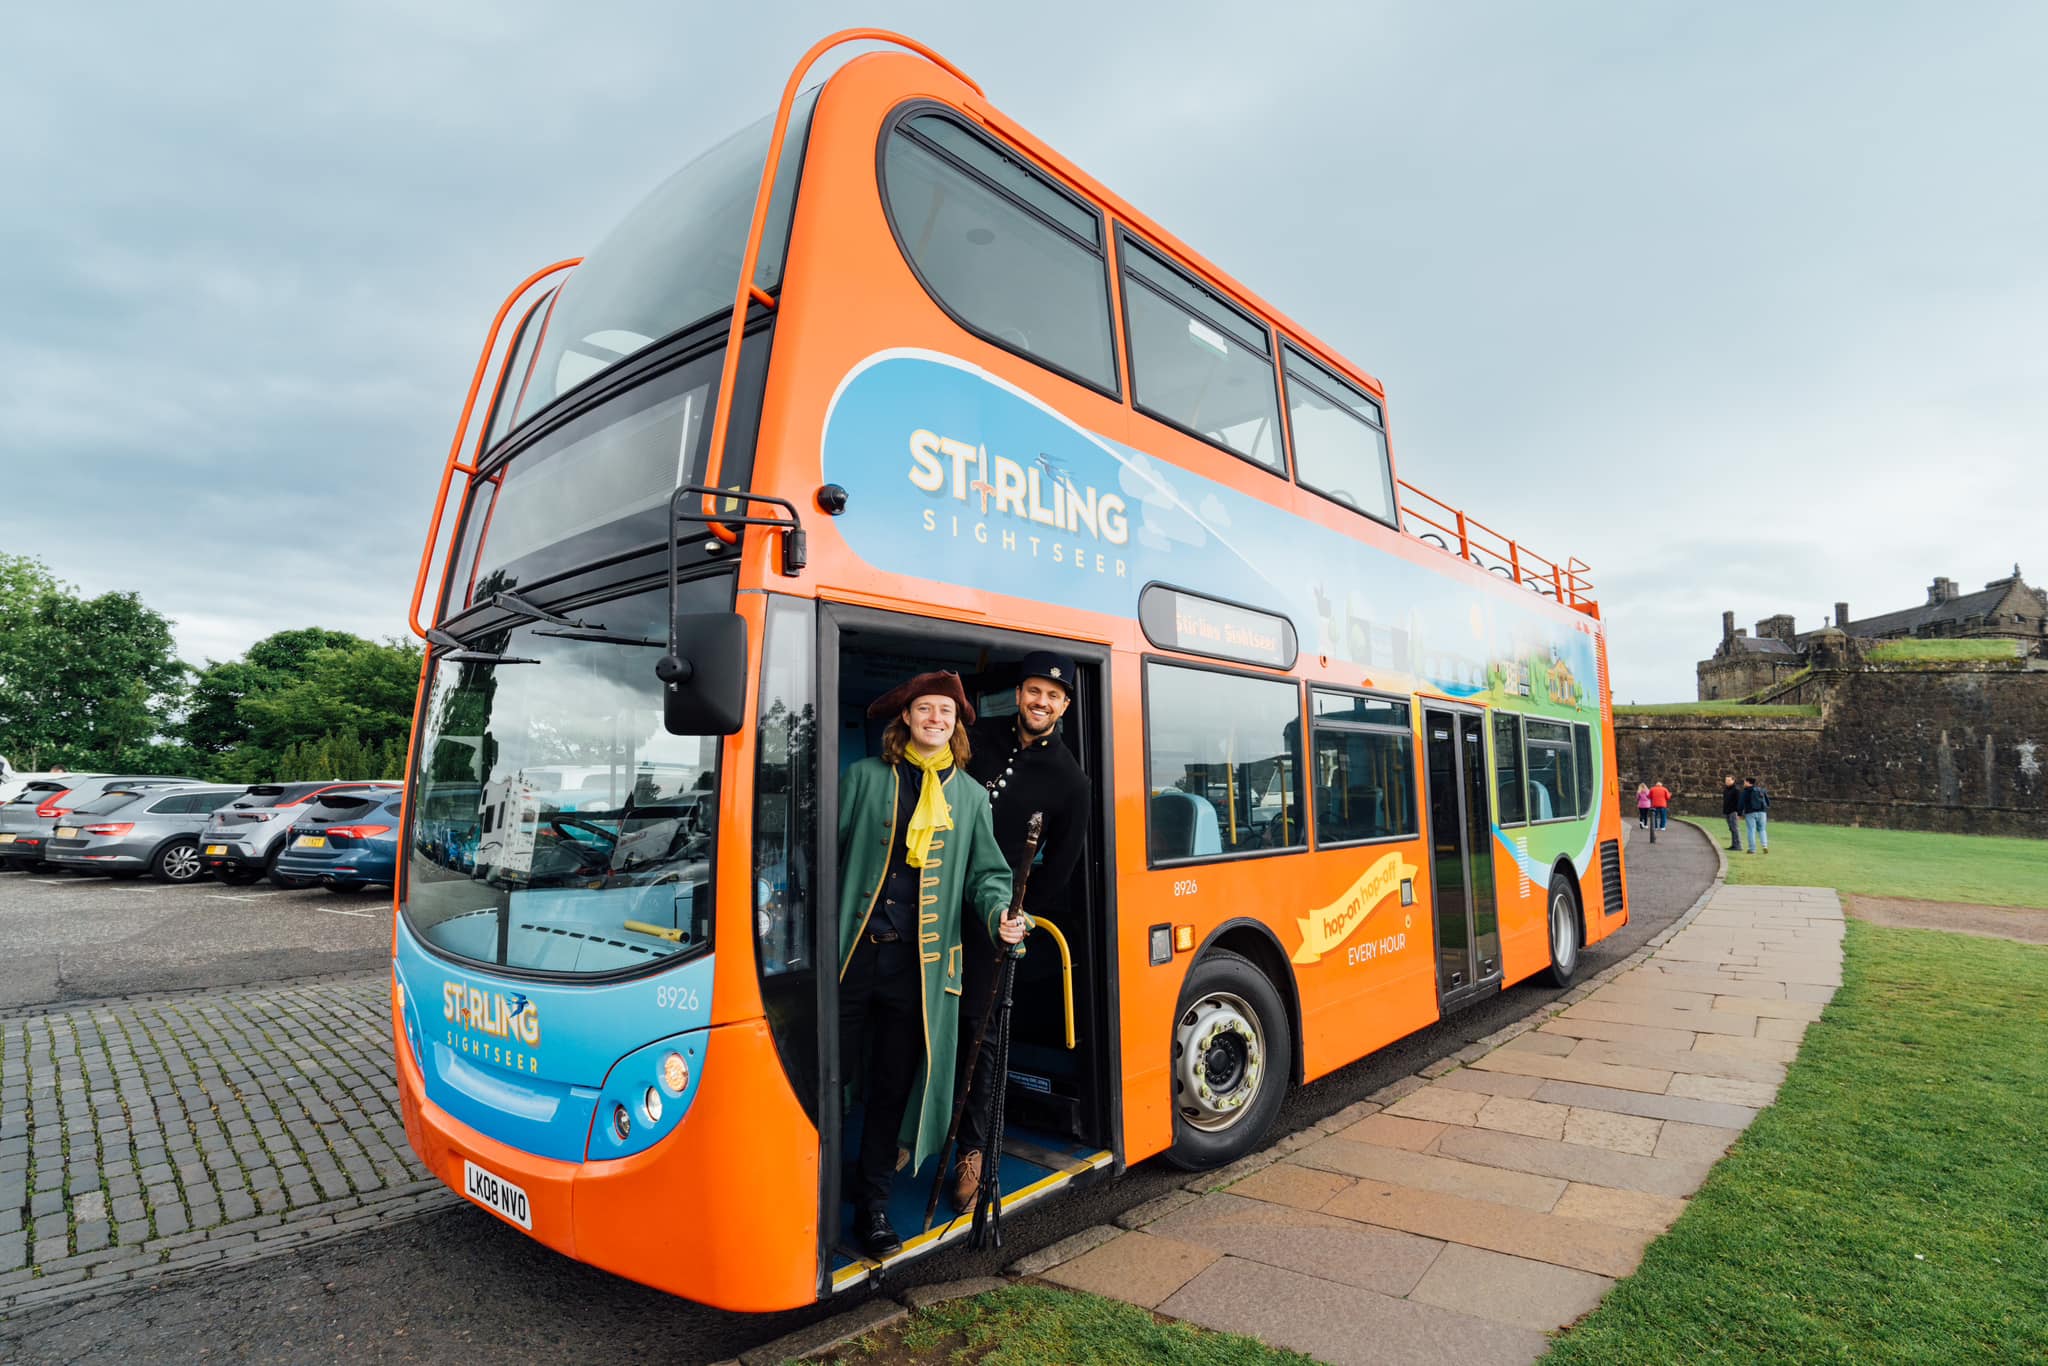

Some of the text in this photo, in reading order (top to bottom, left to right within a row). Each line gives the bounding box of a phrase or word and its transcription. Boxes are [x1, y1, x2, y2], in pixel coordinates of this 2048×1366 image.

[908, 428, 1129, 545] STIRLING
[922, 508, 1127, 577] SIGHTSEER
[1173, 880, 1198, 896] 8926
[1323, 861, 1397, 939] hop-on hop-off
[1348, 933, 1407, 967] EVERY HOUR
[443, 980, 540, 1045] STIRLING
[656, 985, 699, 1011] 8926
[447, 1030, 538, 1073] SIGHTSEER
[468, 1166, 527, 1222] LK08 NVO
